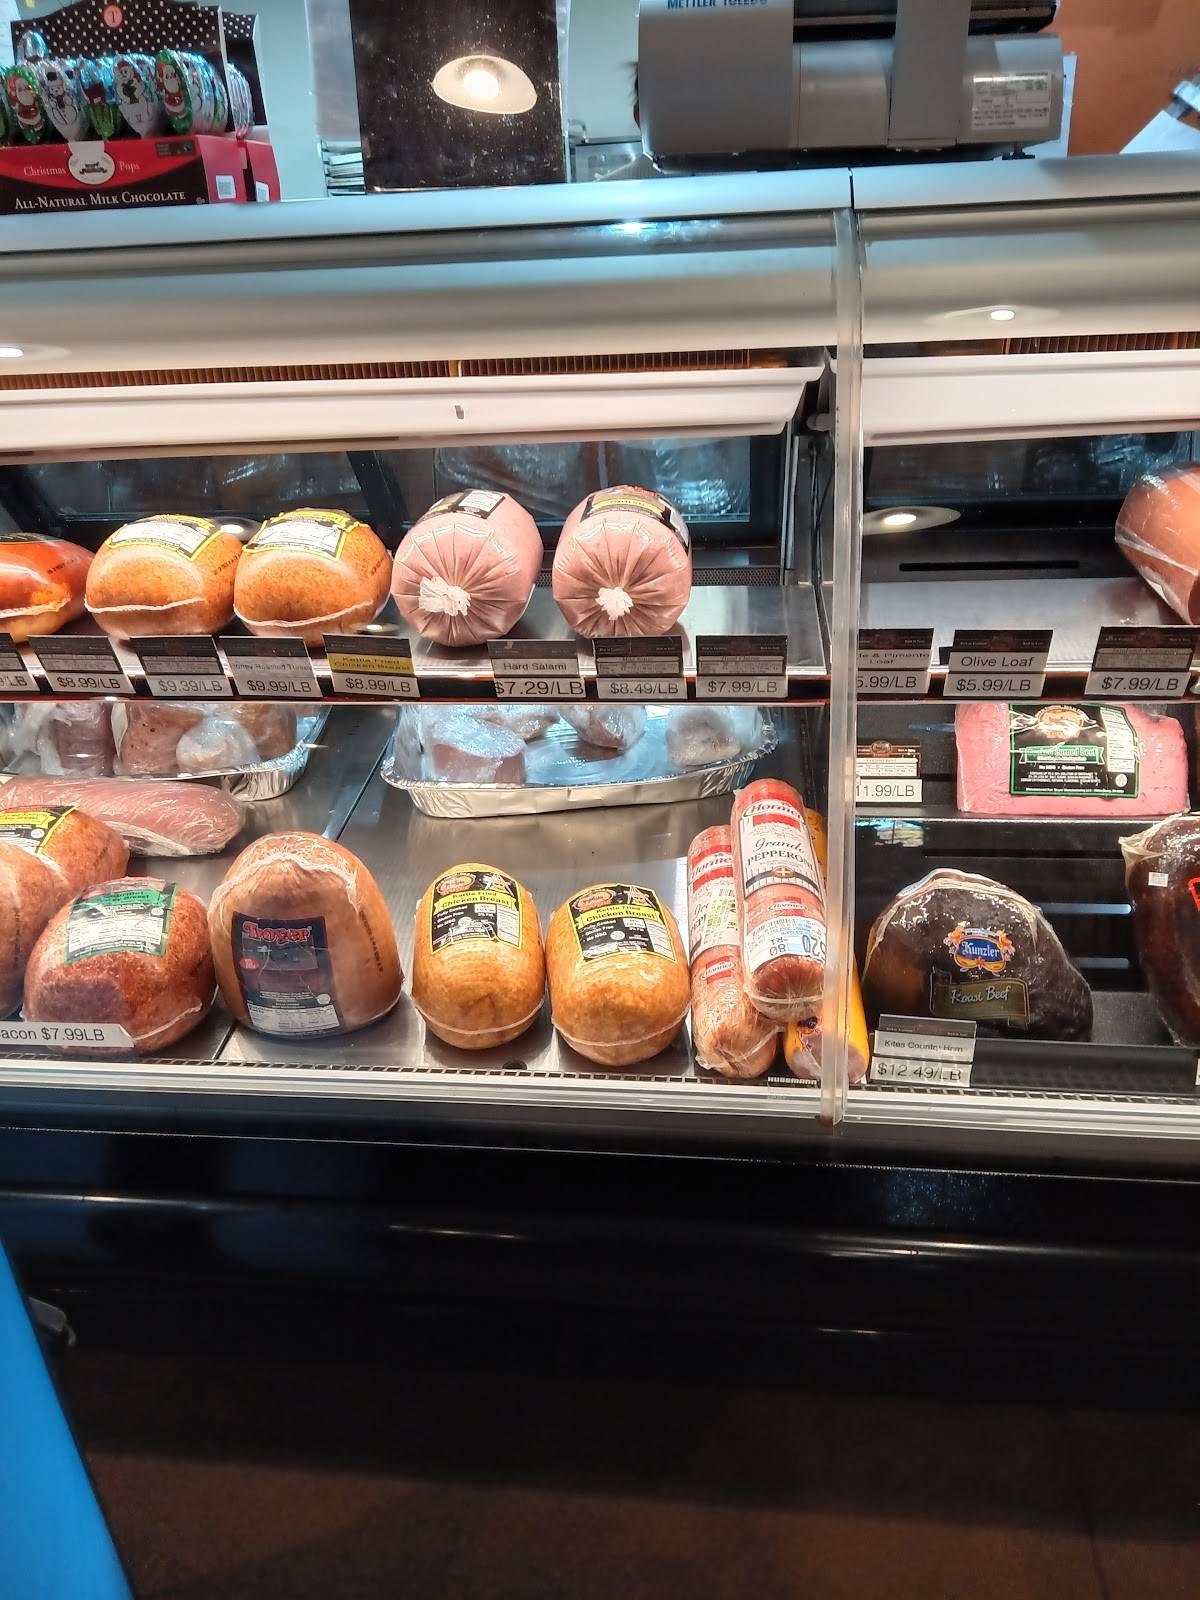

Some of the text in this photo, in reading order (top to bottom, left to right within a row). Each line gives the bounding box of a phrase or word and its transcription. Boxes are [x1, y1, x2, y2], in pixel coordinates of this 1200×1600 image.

[667, 0, 716, 8] METTLER
[23, 166, 66, 177] Christmas
[119, 161, 139, 172] Pops
[15, 191, 186, 209] ALL-NATURAL MILK CHOCOLATE
[503, 662, 567, 671] Hard Salami
[960, 656, 1035, 667] Olive Loaf
[56, 676, 121, 689] $8.99/LB
[158, 680, 223, 692] $9.39/LB
[247, 680, 312, 692] $9.99/LB
[346, 678, 411, 693] $8.99/LB
[495, 681, 584, 696] $7.29/LB
[610, 682, 679, 695] $8.49/LB
[708, 681, 778, 694] $7.99/LB
[956, 678, 1032, 692] $5.99/LB
[1102, 676, 1179, 690] $7.99/LB
[747, 850, 814, 870] PEPPERONI
[442, 897, 478, 908] Chicken
[480, 896, 510, 906] Breast
[586, 910, 655, 922] Chicken Breast
[243, 921, 312, 946] Troyer
[961, 941, 1000, 958] Kunzler
[951, 985, 1011, 1004] Roast Beef
[0, 1027, 105, 1041] acon $7.99LB
[877, 1062, 961, 1081] $12.49/LB
